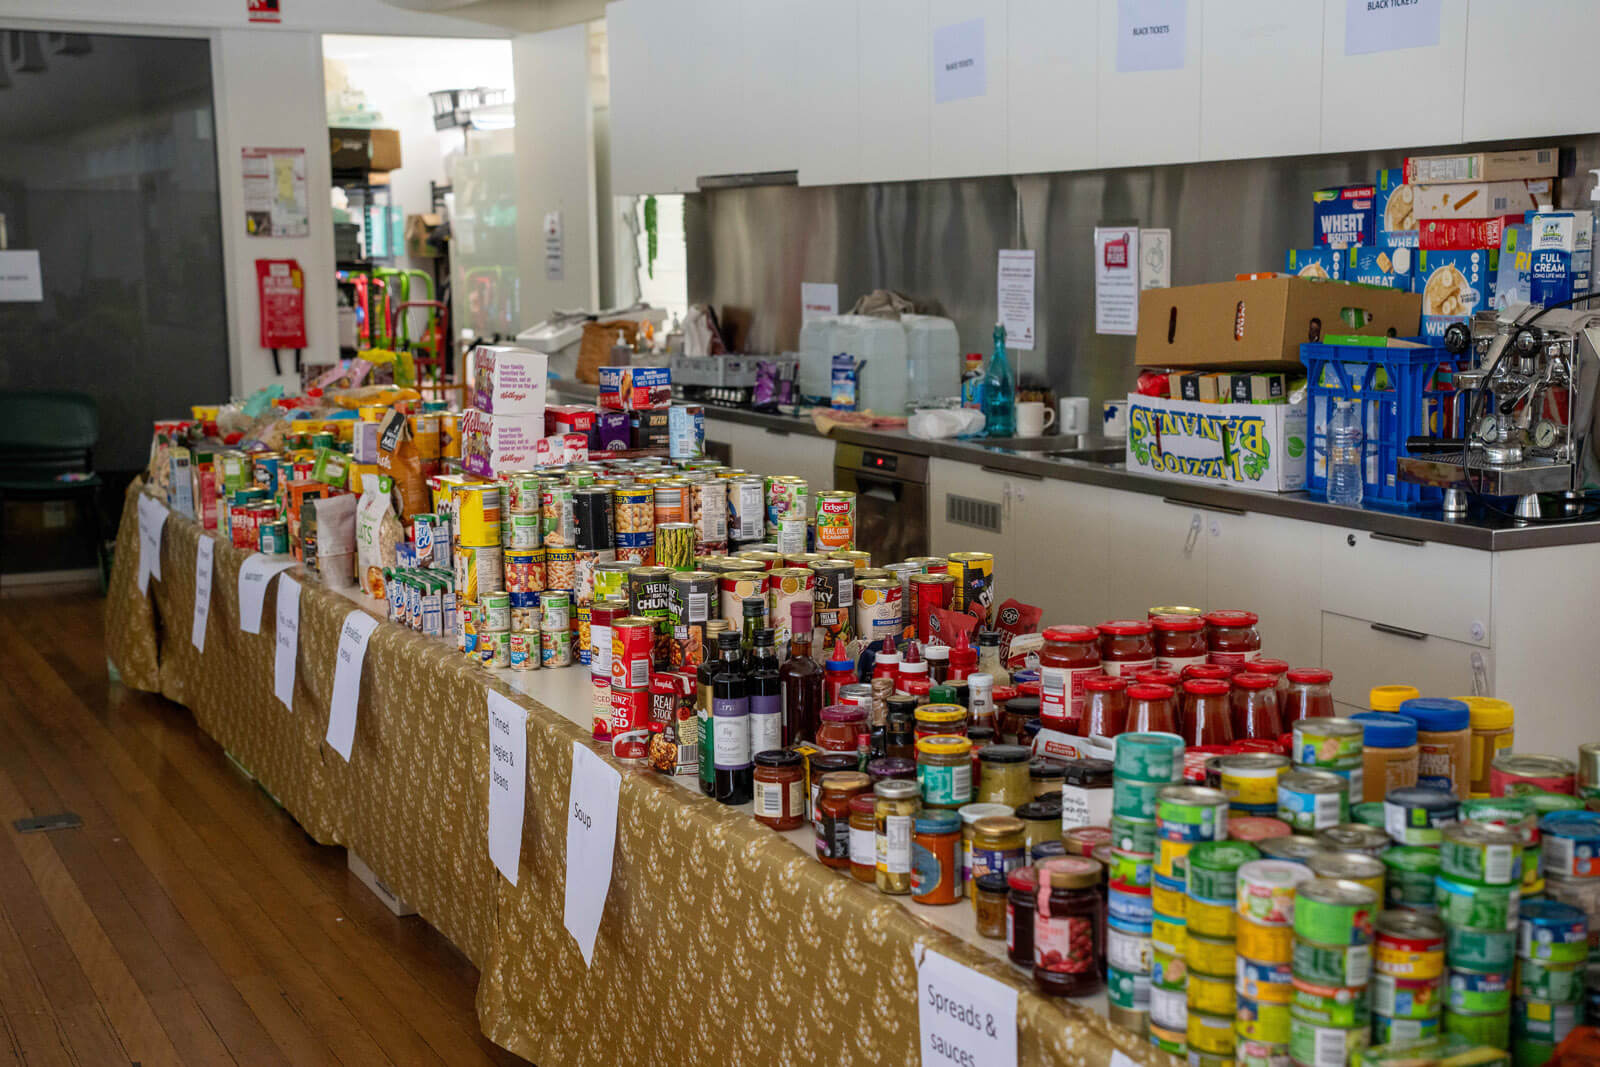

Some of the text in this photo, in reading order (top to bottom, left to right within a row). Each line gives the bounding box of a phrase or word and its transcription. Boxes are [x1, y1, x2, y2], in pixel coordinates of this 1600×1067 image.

[1367, 0, 1388, 11] BLACK
[1132, 25, 1170, 36] BLACK TICKETS
[1320, 213, 1365, 233] WHEAT
[1514, 251, 1532, 271] RI
[1540, 253, 1561, 263] FULL
[1533, 263, 1566, 273] CREAM
[1357, 275, 1396, 288] WHEAT
[1129, 403, 1266, 457] BANANAS
[824, 503, 849, 512] Edgell
[637, 598, 669, 610] CHUN
[612, 696, 628, 705] EINZ
[653, 695, 673, 710] REAL
[653, 709, 672, 720] STOCK
[491, 711, 510, 735] Tinned
[509, 751, 514, 767] &
[493, 767, 509, 792] beans
[573, 801, 592, 829] Soup
[927, 983, 999, 1040] Spreads &
[930, 1033, 975, 1067] sauces
